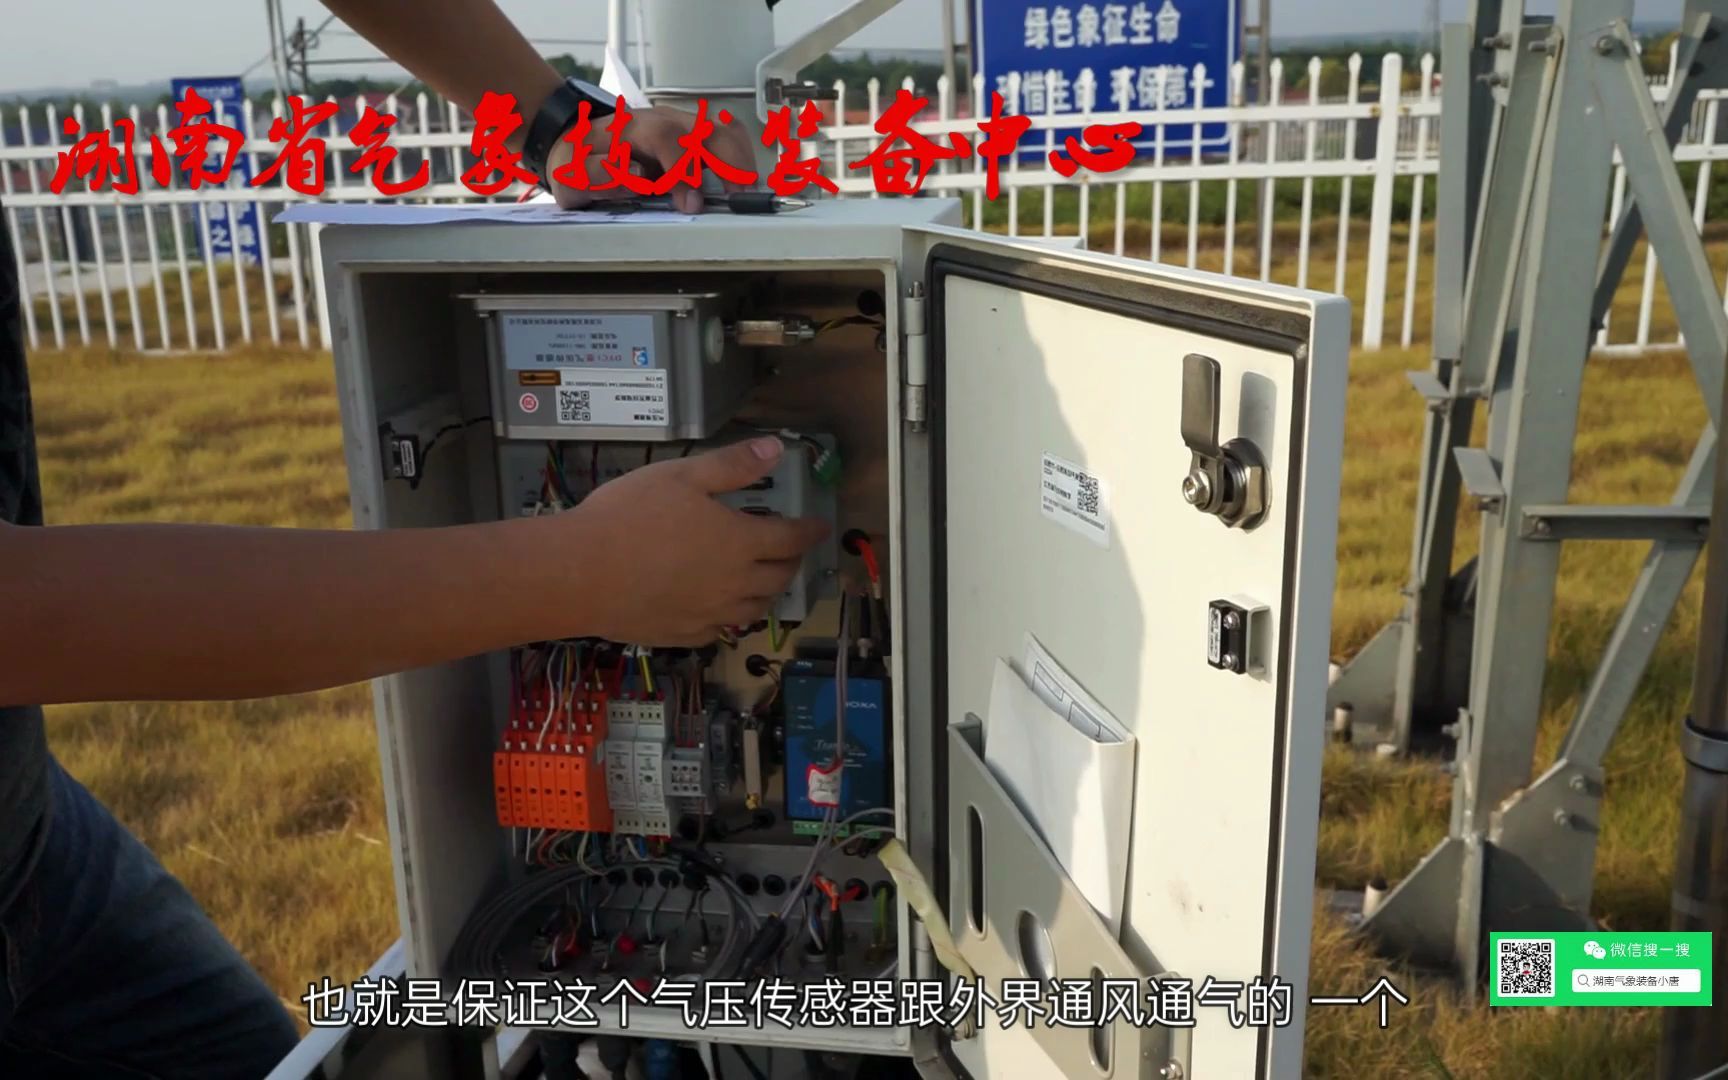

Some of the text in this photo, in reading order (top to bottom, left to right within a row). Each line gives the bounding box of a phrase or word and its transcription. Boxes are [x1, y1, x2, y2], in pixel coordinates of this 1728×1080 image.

[1024, 1, 1181, 48] 绿色象征生命
